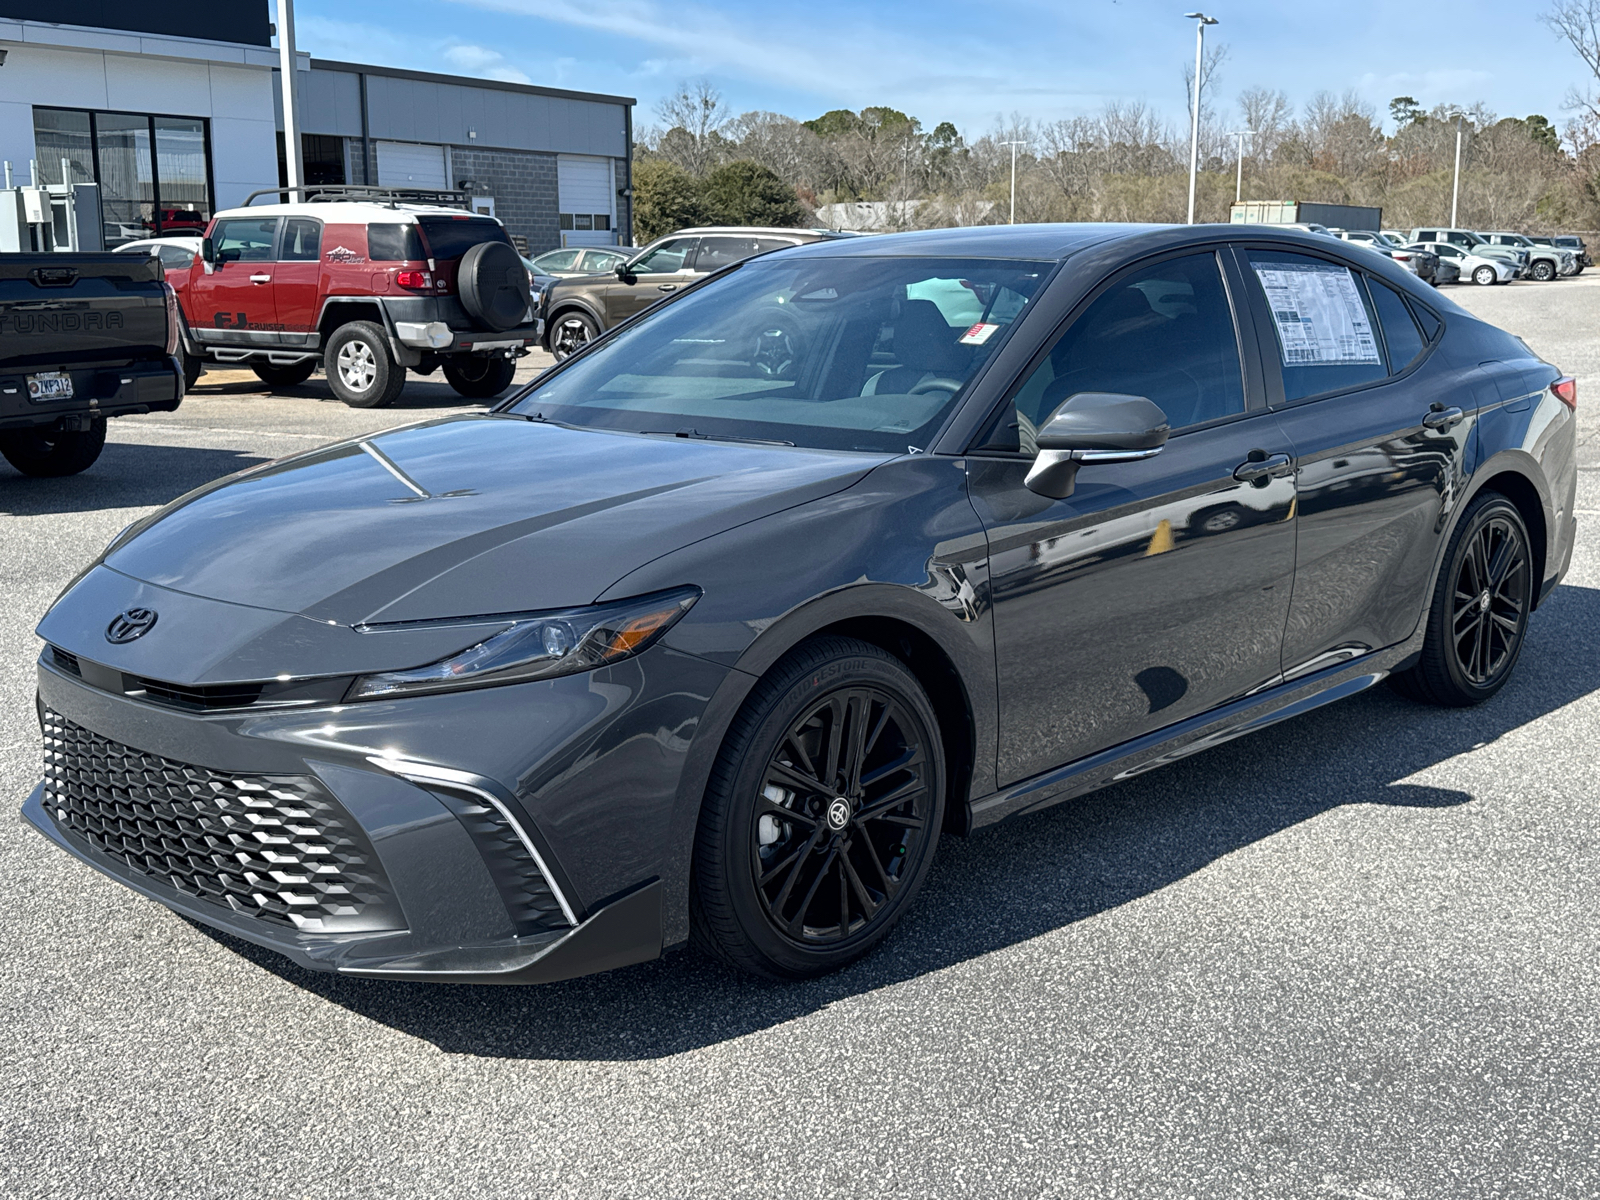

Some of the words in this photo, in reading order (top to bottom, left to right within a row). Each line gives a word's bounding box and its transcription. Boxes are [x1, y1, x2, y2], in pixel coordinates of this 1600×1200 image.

[326, 253, 351, 264] TRD
[214, 311, 247, 329] FJ
[248, 322, 285, 331] CRUISER
[38, 378, 71, 393] ZKF312
[781, 659, 868, 715] BRIDGESTONE
